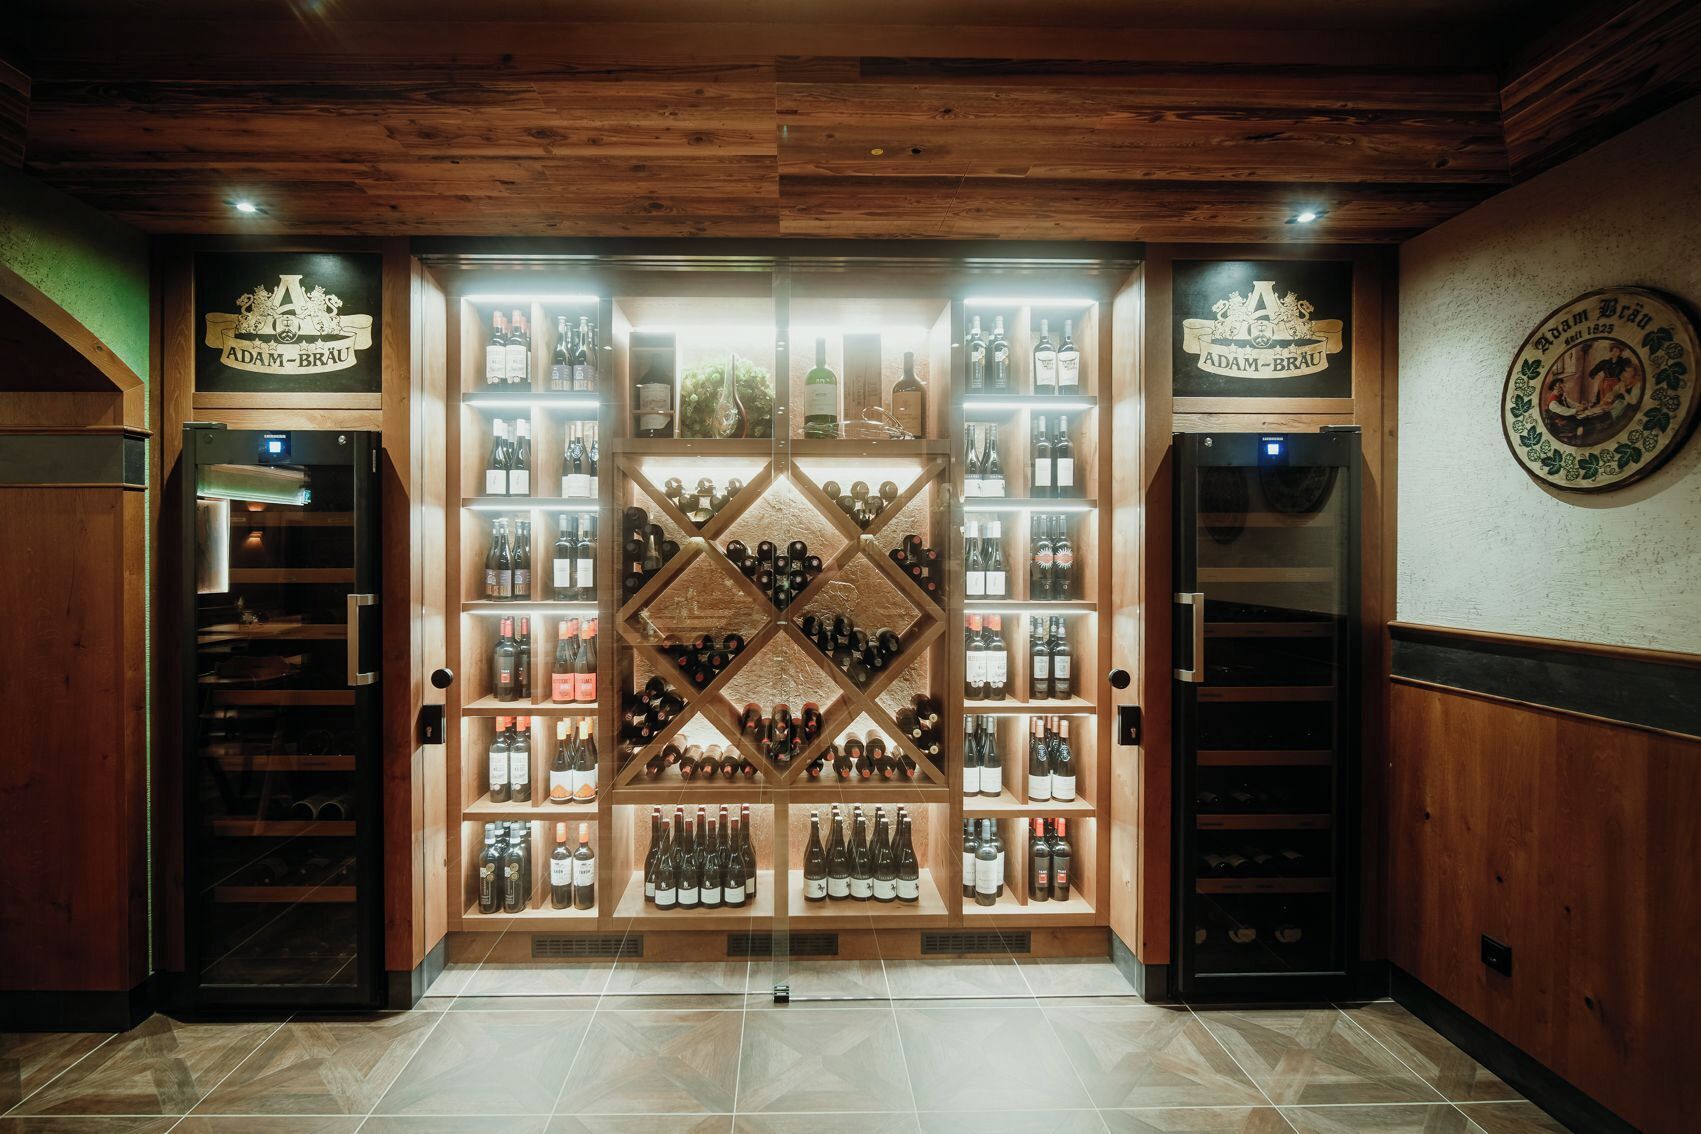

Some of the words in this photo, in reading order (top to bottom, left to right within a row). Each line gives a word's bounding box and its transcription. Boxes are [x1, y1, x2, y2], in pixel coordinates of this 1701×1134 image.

[1534, 308, 1589, 354] Adam
[1597, 298, 1653, 331] Bräu
[1588, 324, 1615, 335] 1825
[226, 347, 351, 368] ADAM-BRÄU
[1203, 352, 1322, 372] ADAM-BRÄU
